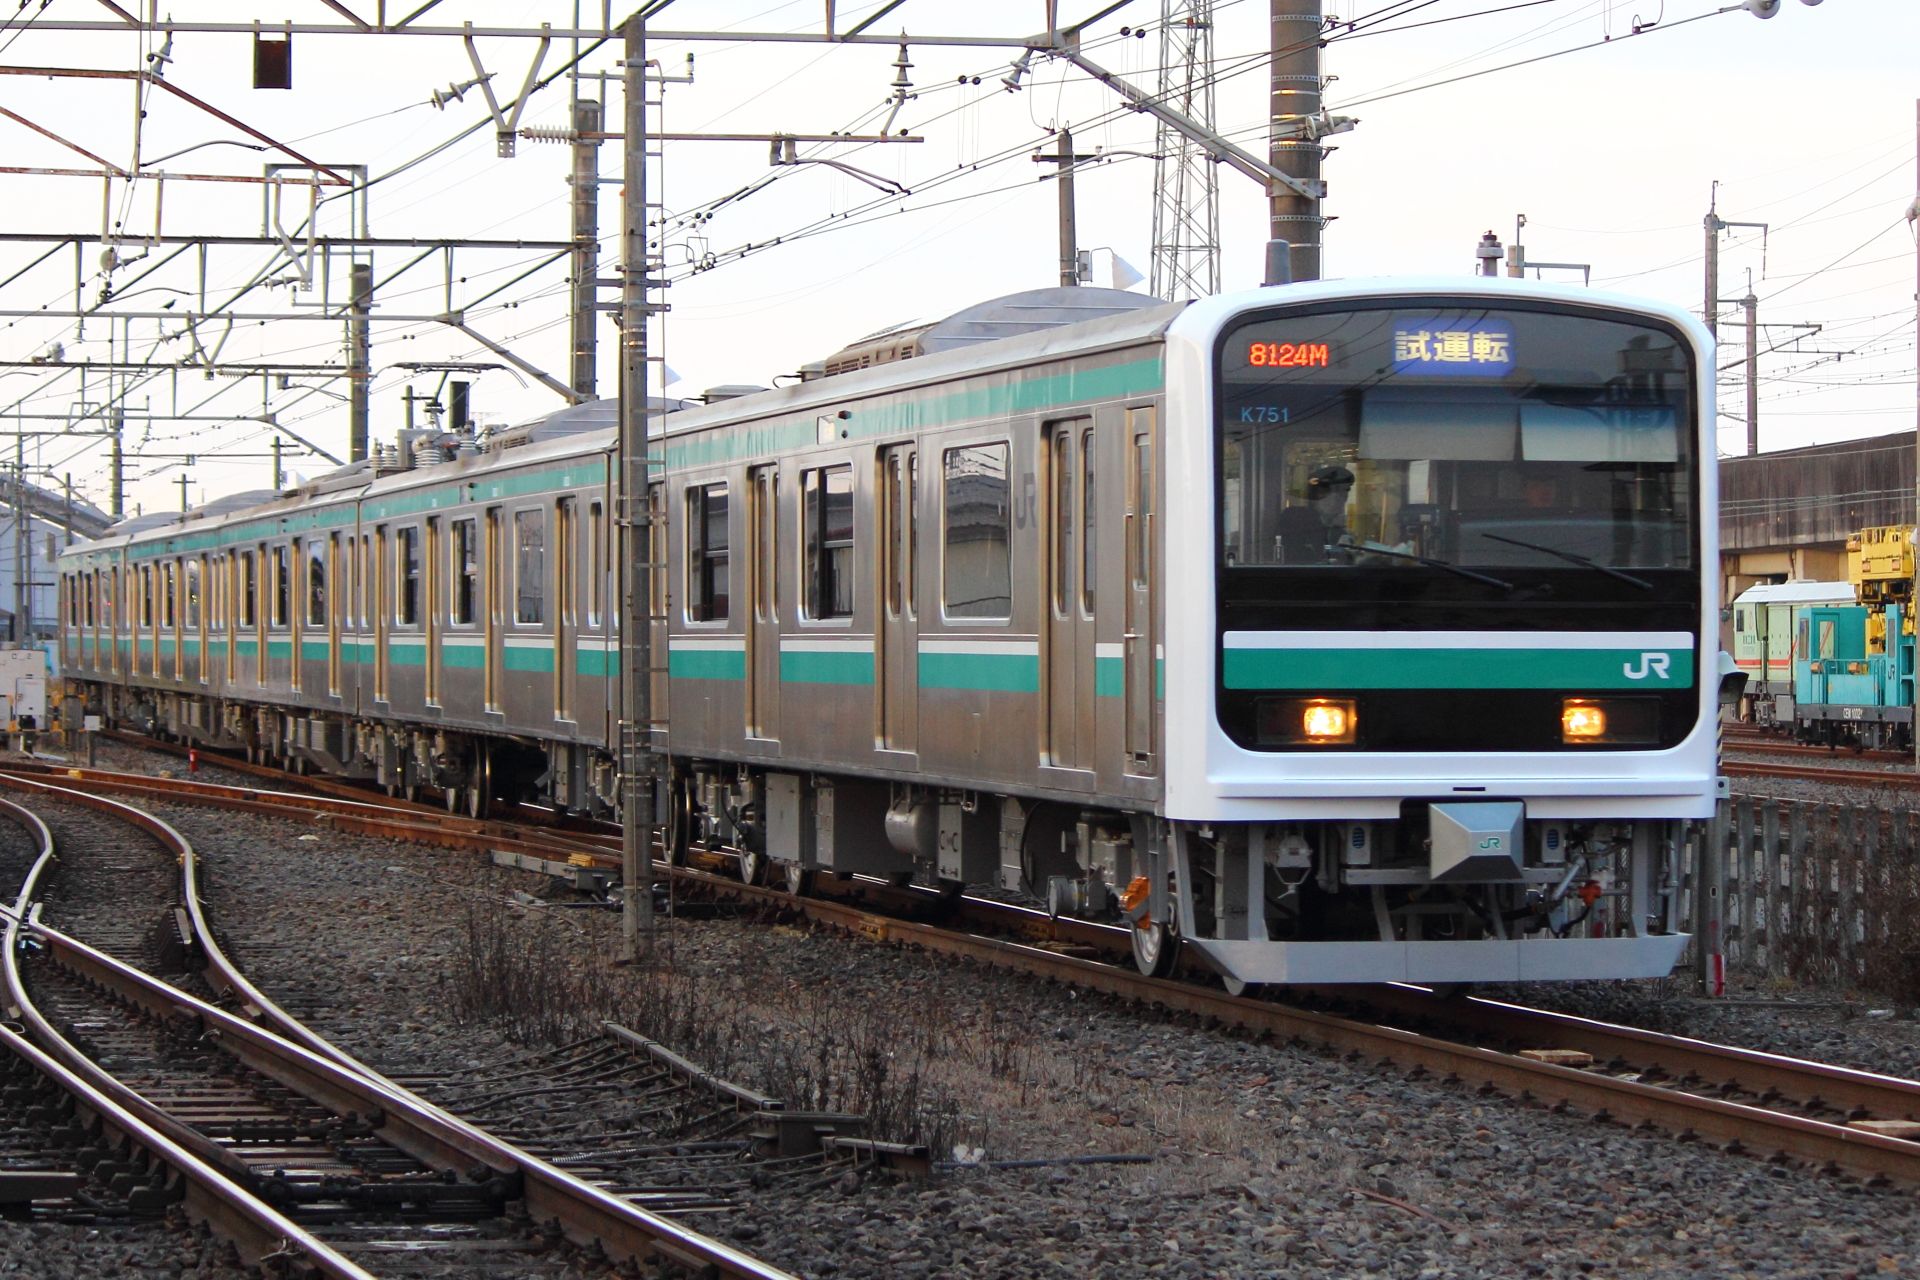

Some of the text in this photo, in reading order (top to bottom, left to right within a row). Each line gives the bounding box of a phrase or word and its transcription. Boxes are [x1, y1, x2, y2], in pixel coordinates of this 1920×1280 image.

[1250, 343, 1328, 367] 8124M
[1395, 331, 1509, 363] 試運転
[1241, 406, 1288, 423] K751
[1623, 652, 1670, 679] JR
[1480, 837, 1500, 849] JR
